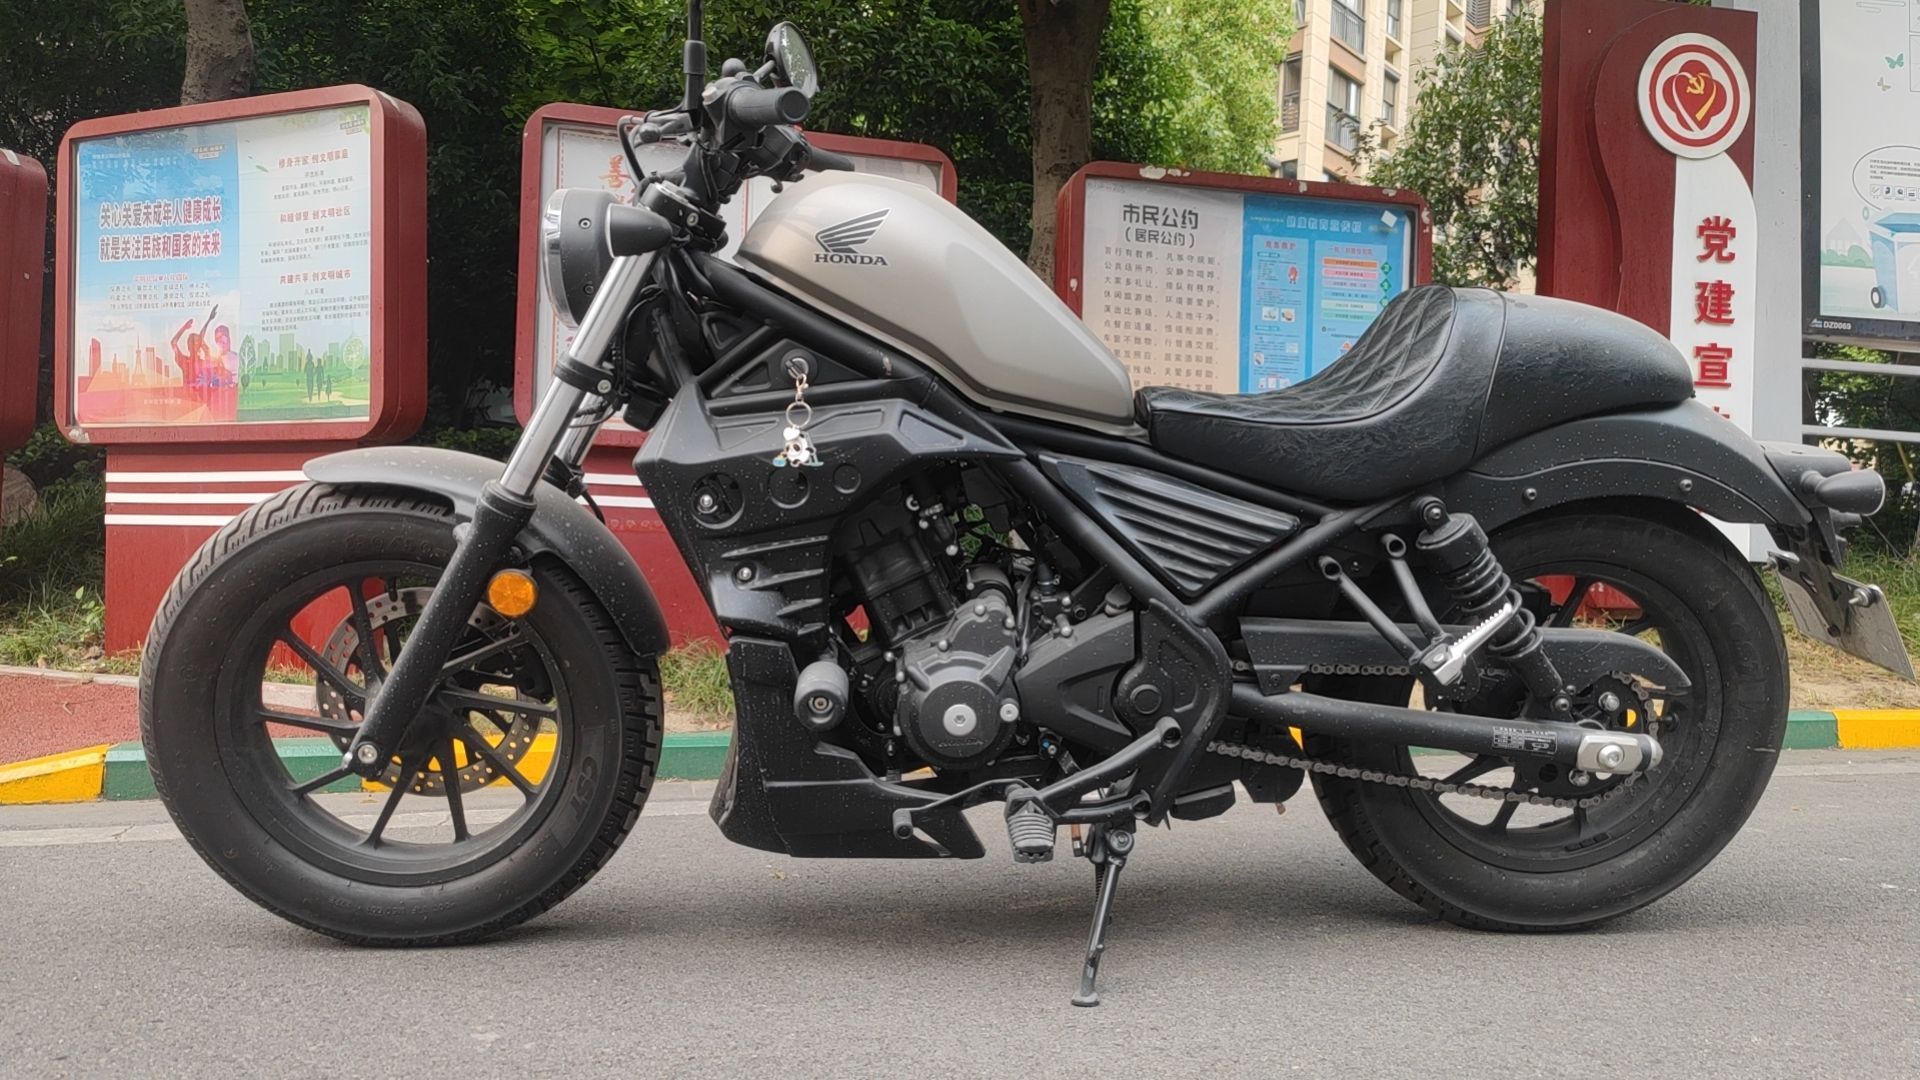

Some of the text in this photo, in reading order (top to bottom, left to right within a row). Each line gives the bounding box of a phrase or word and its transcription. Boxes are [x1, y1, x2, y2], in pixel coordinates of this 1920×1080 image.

[100, 197, 221, 228] 关心关爱未成年人健康成长
[1122, 203, 1199, 230] 市民公约
[99, 231, 220, 262] 就是关注民族和国家的未来
[1125, 227, 1195, 249] （居民公约）
[814, 253, 889, 266] HONDA
[1694, 215, 1737, 419] 党建宣
